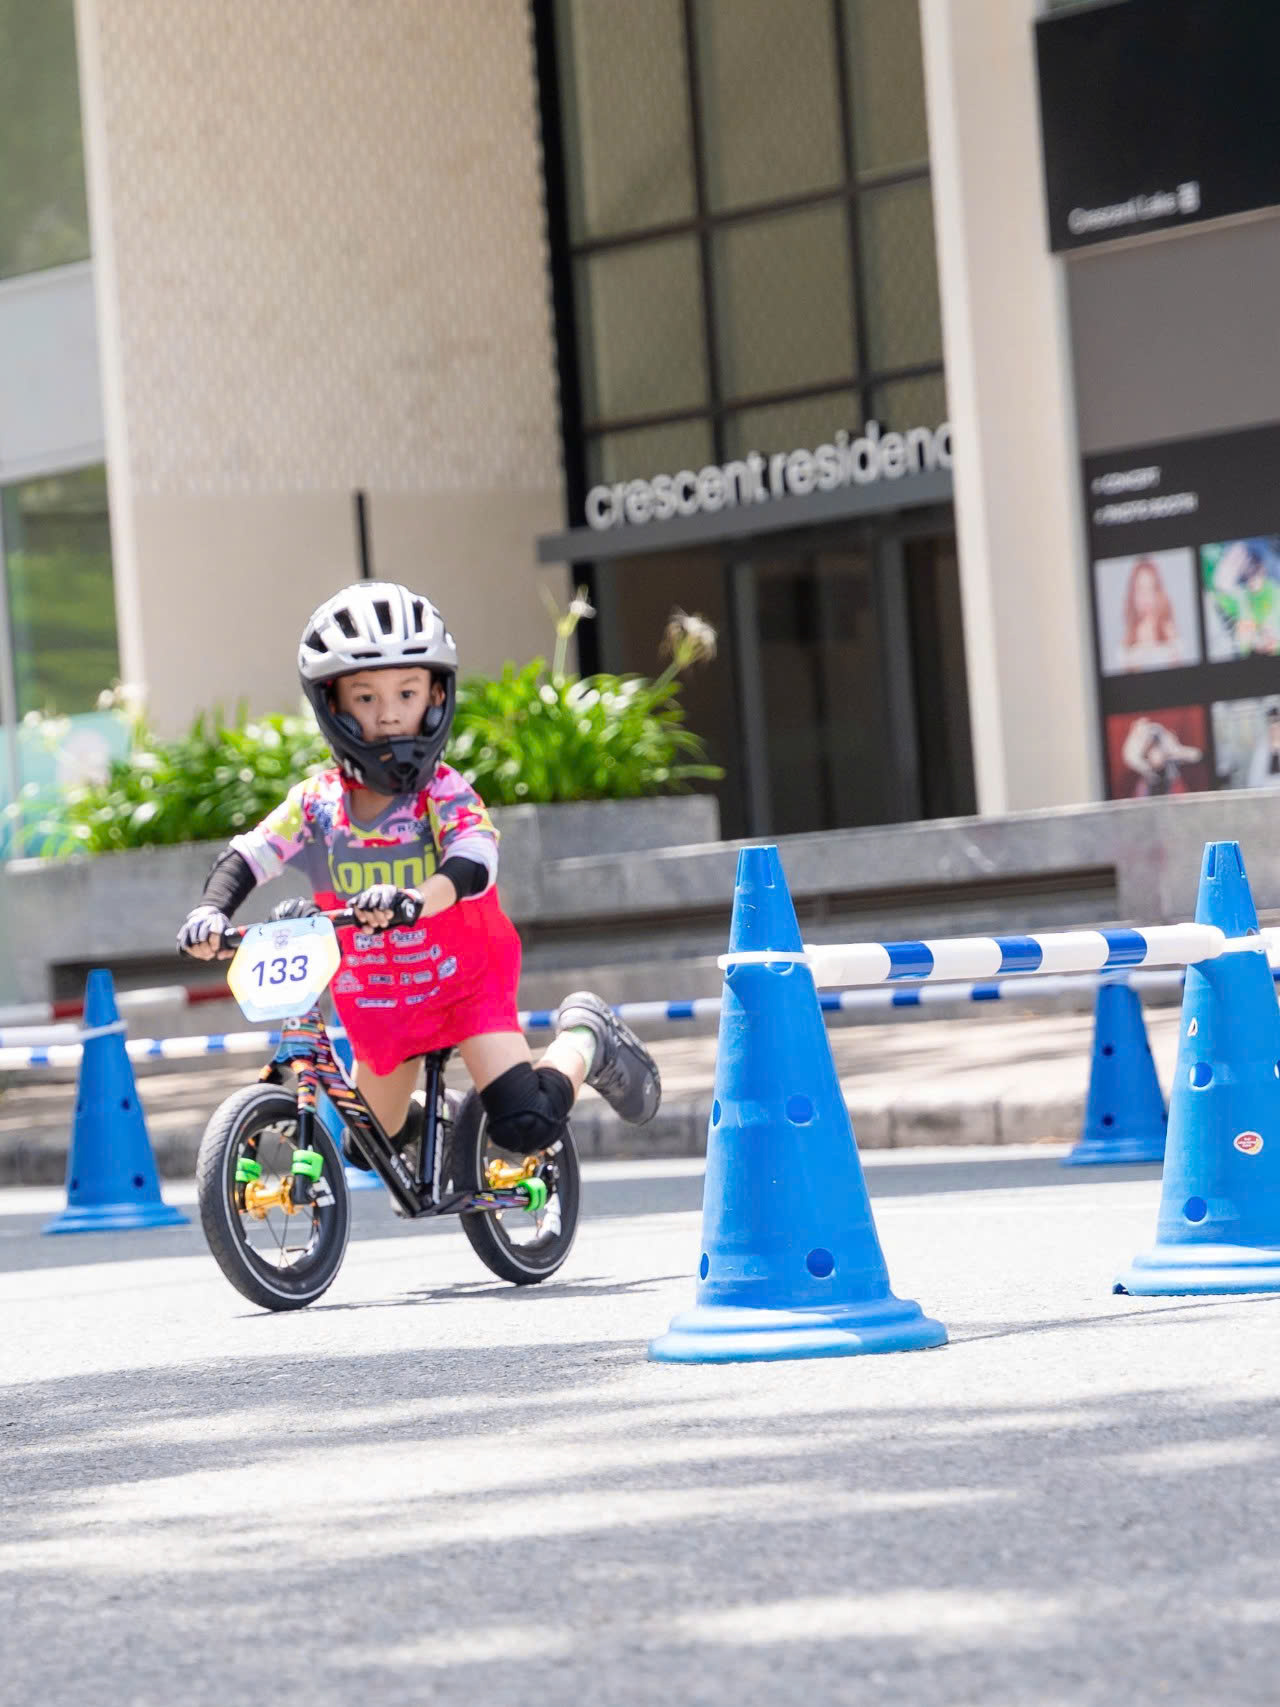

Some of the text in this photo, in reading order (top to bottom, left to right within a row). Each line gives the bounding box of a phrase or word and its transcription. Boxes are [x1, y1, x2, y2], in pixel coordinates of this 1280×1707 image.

[585, 451, 768, 531] crescent
[328, 843, 436, 895] onni
[252, 955, 308, 986] 133
